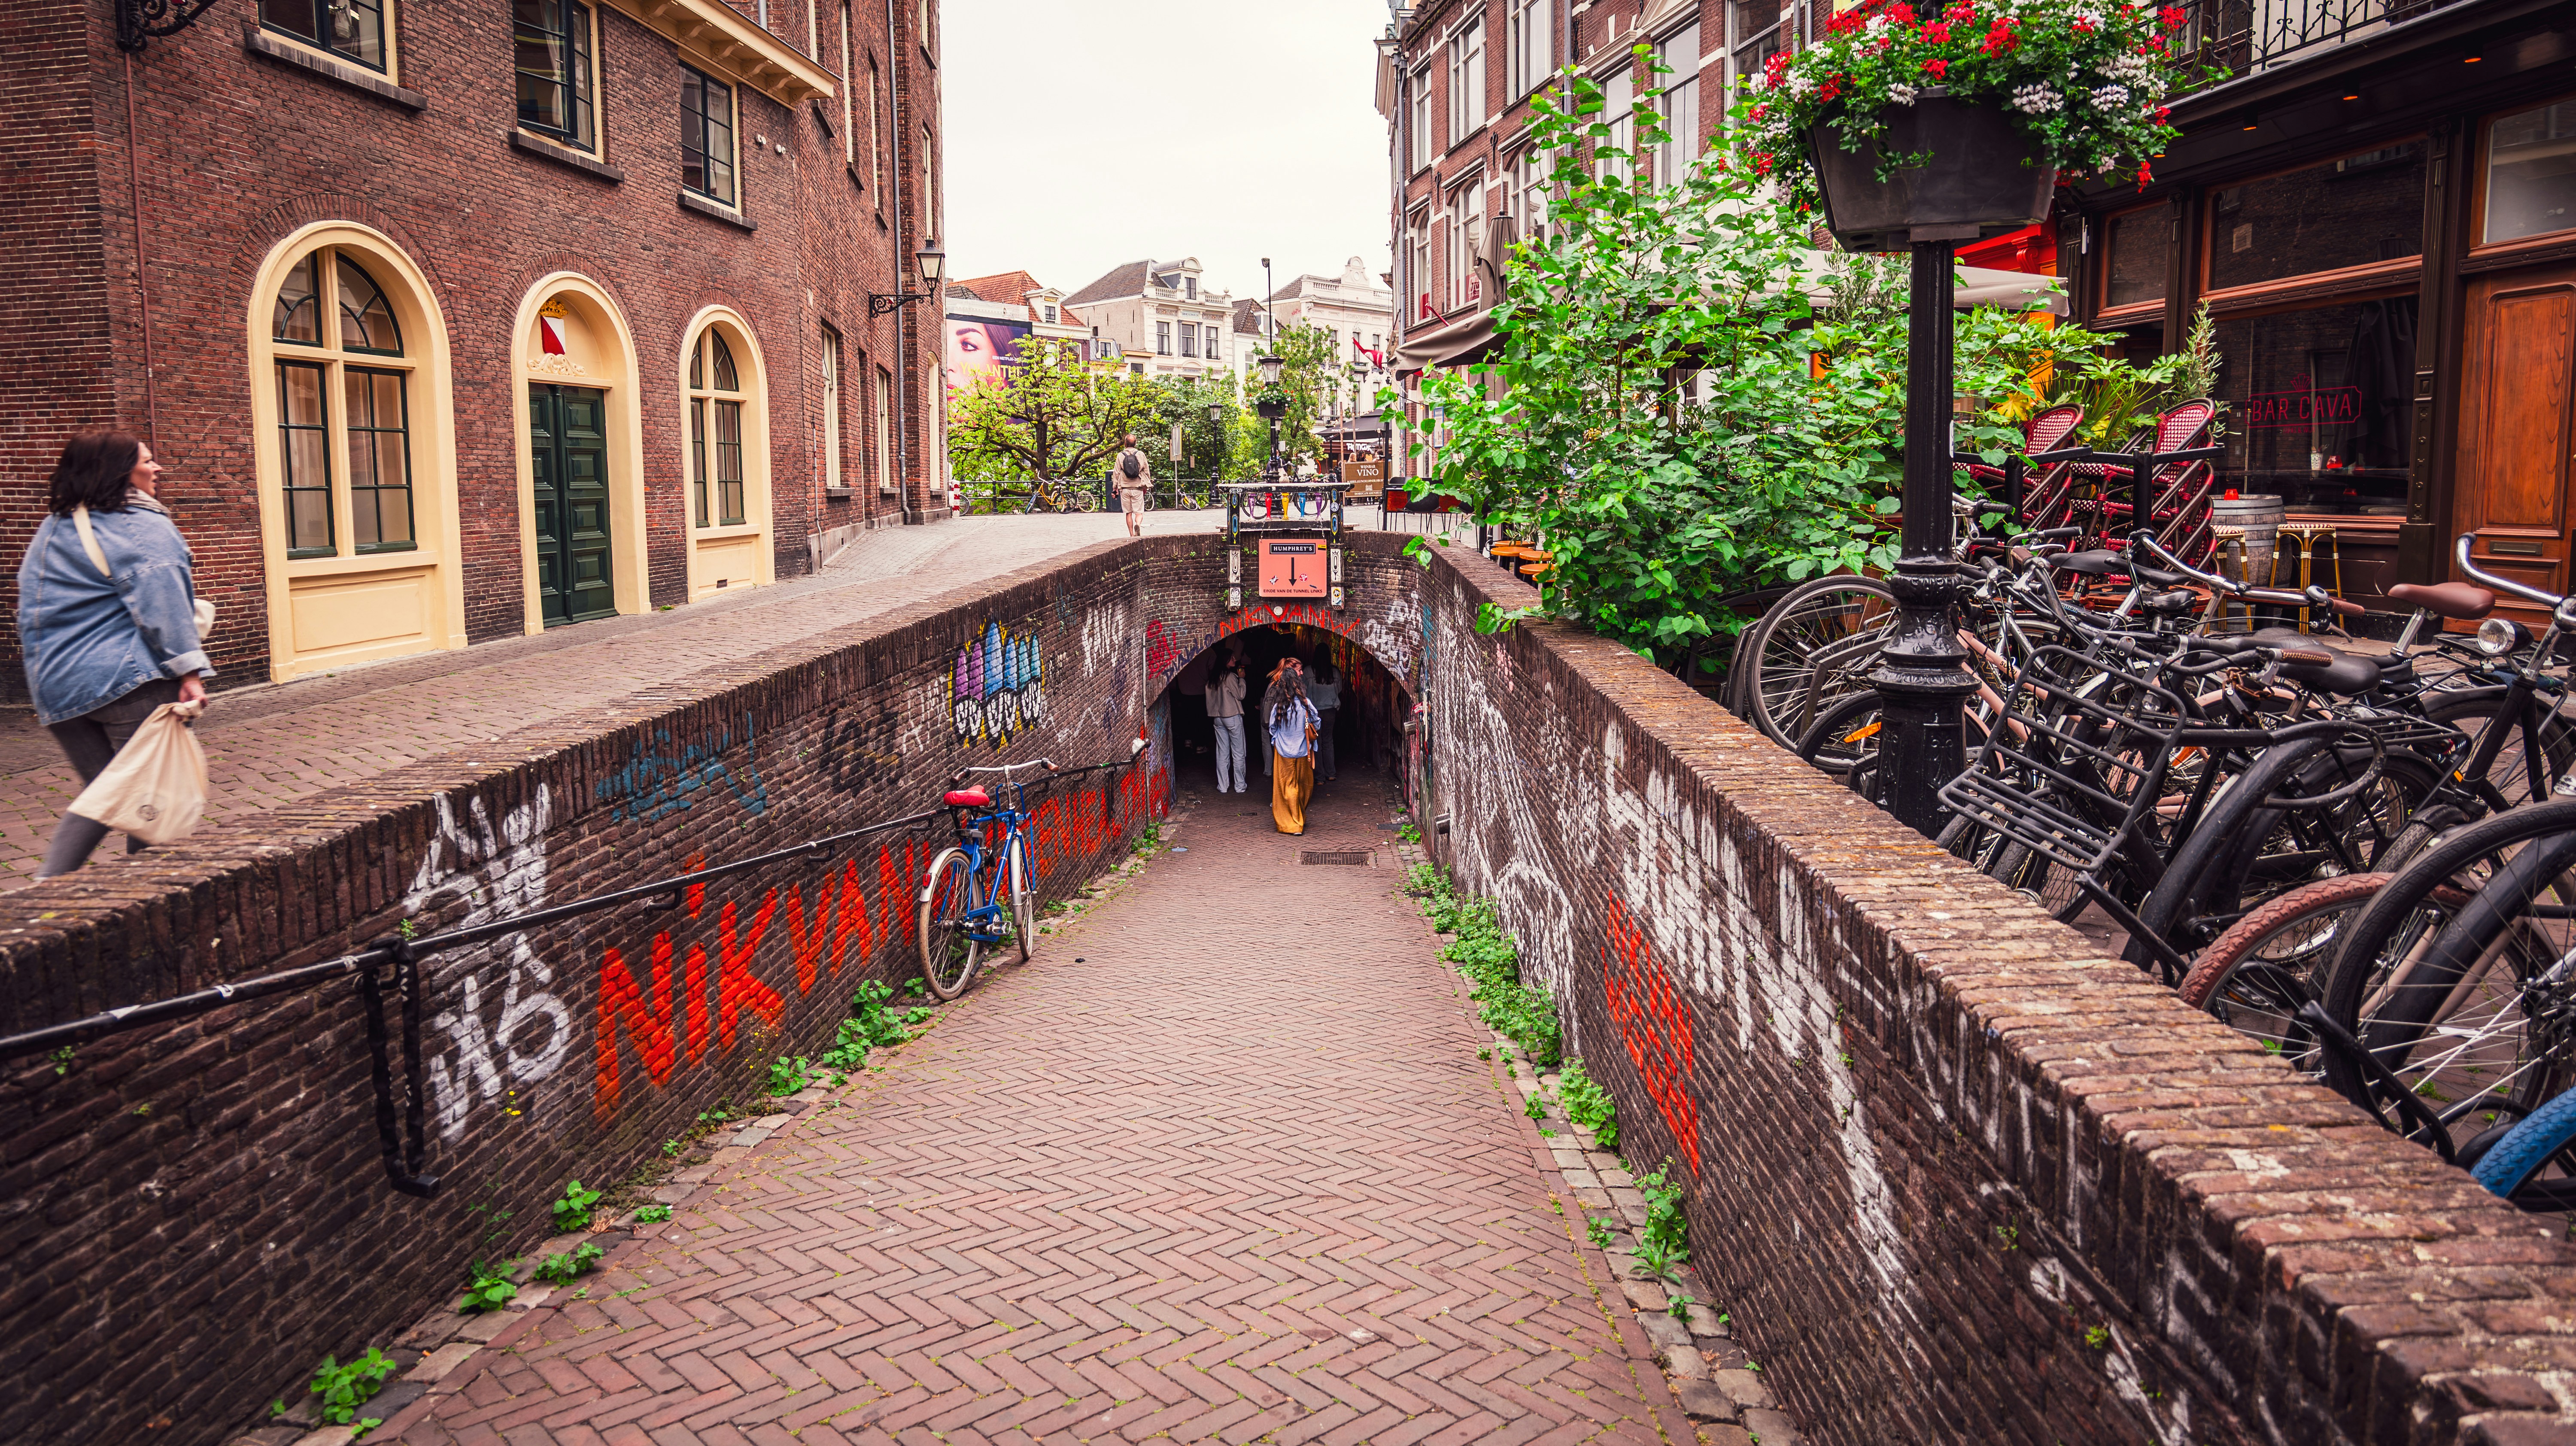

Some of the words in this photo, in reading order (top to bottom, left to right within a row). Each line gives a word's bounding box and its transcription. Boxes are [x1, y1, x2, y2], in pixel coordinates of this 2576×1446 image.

[2252, 398, 2288, 422] BAR
[2300, 394, 2351, 419] CAVA
[1357, 468, 1379, 477] VINO
